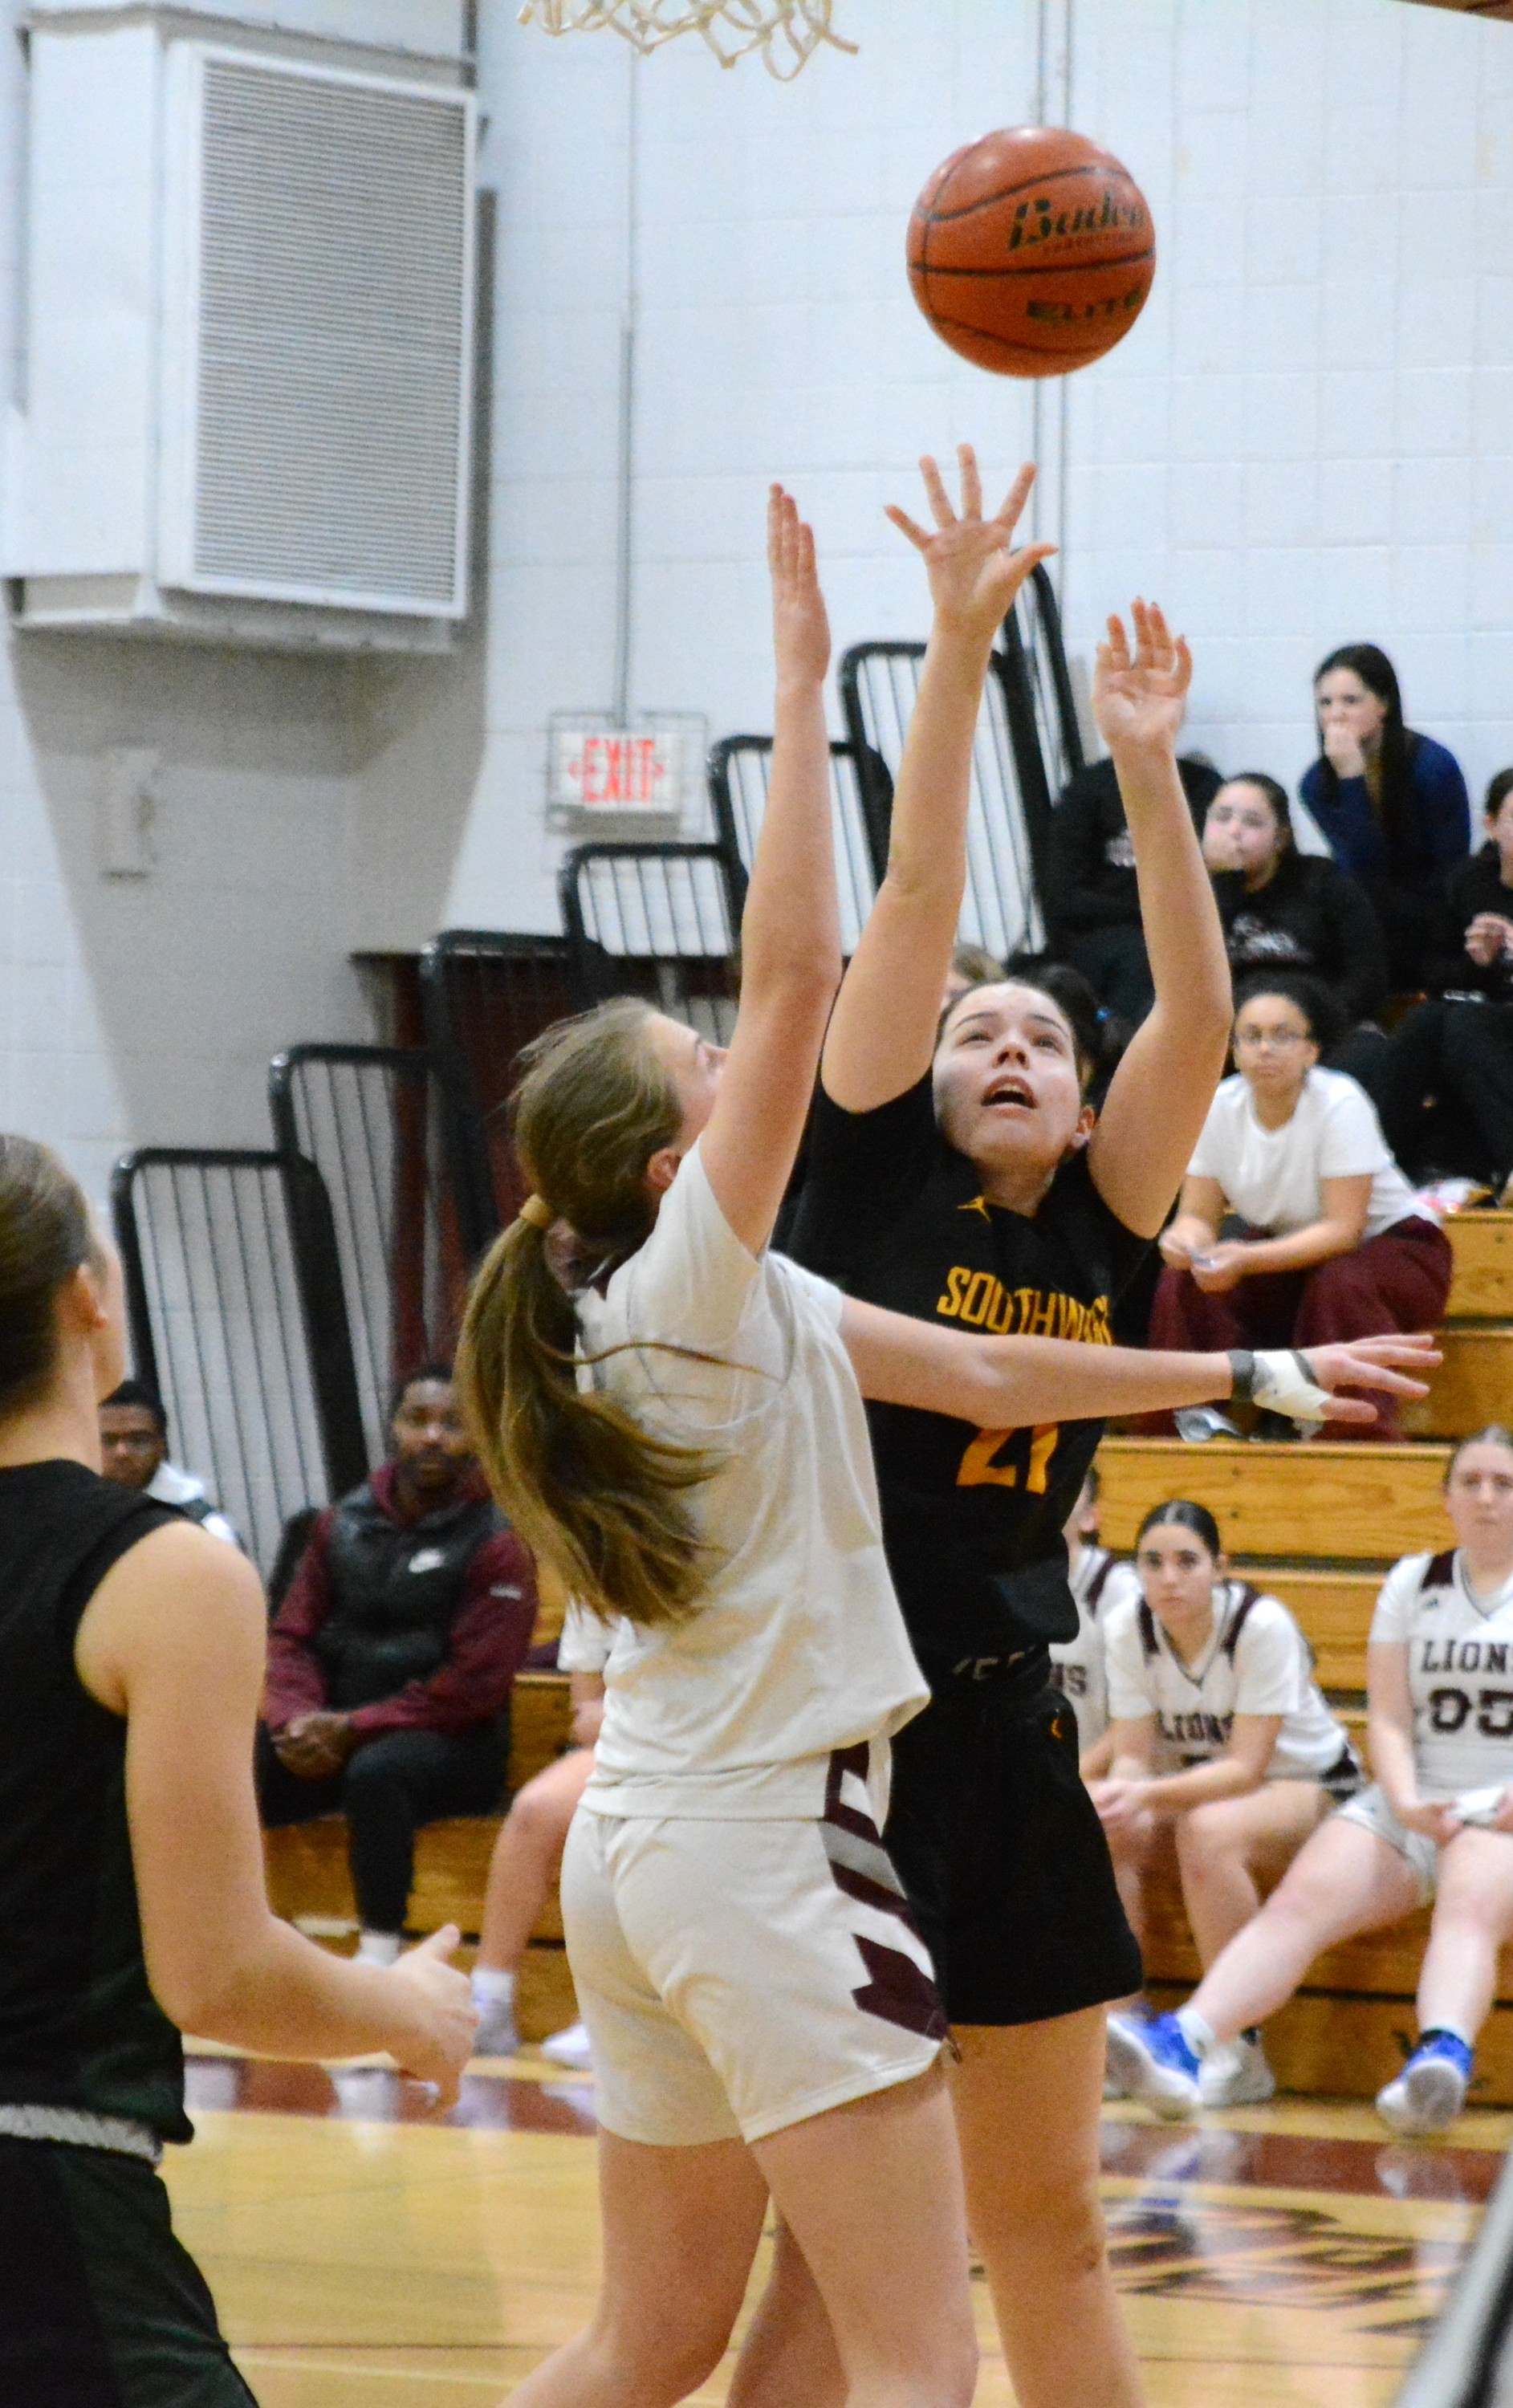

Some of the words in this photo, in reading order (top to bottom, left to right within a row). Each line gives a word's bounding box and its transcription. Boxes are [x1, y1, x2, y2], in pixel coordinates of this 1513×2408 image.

[582, 738, 655, 803] EXIT
[937, 1266, 1112, 1346] SOUTHW
[1421, 1639, 1513, 1672] LION
